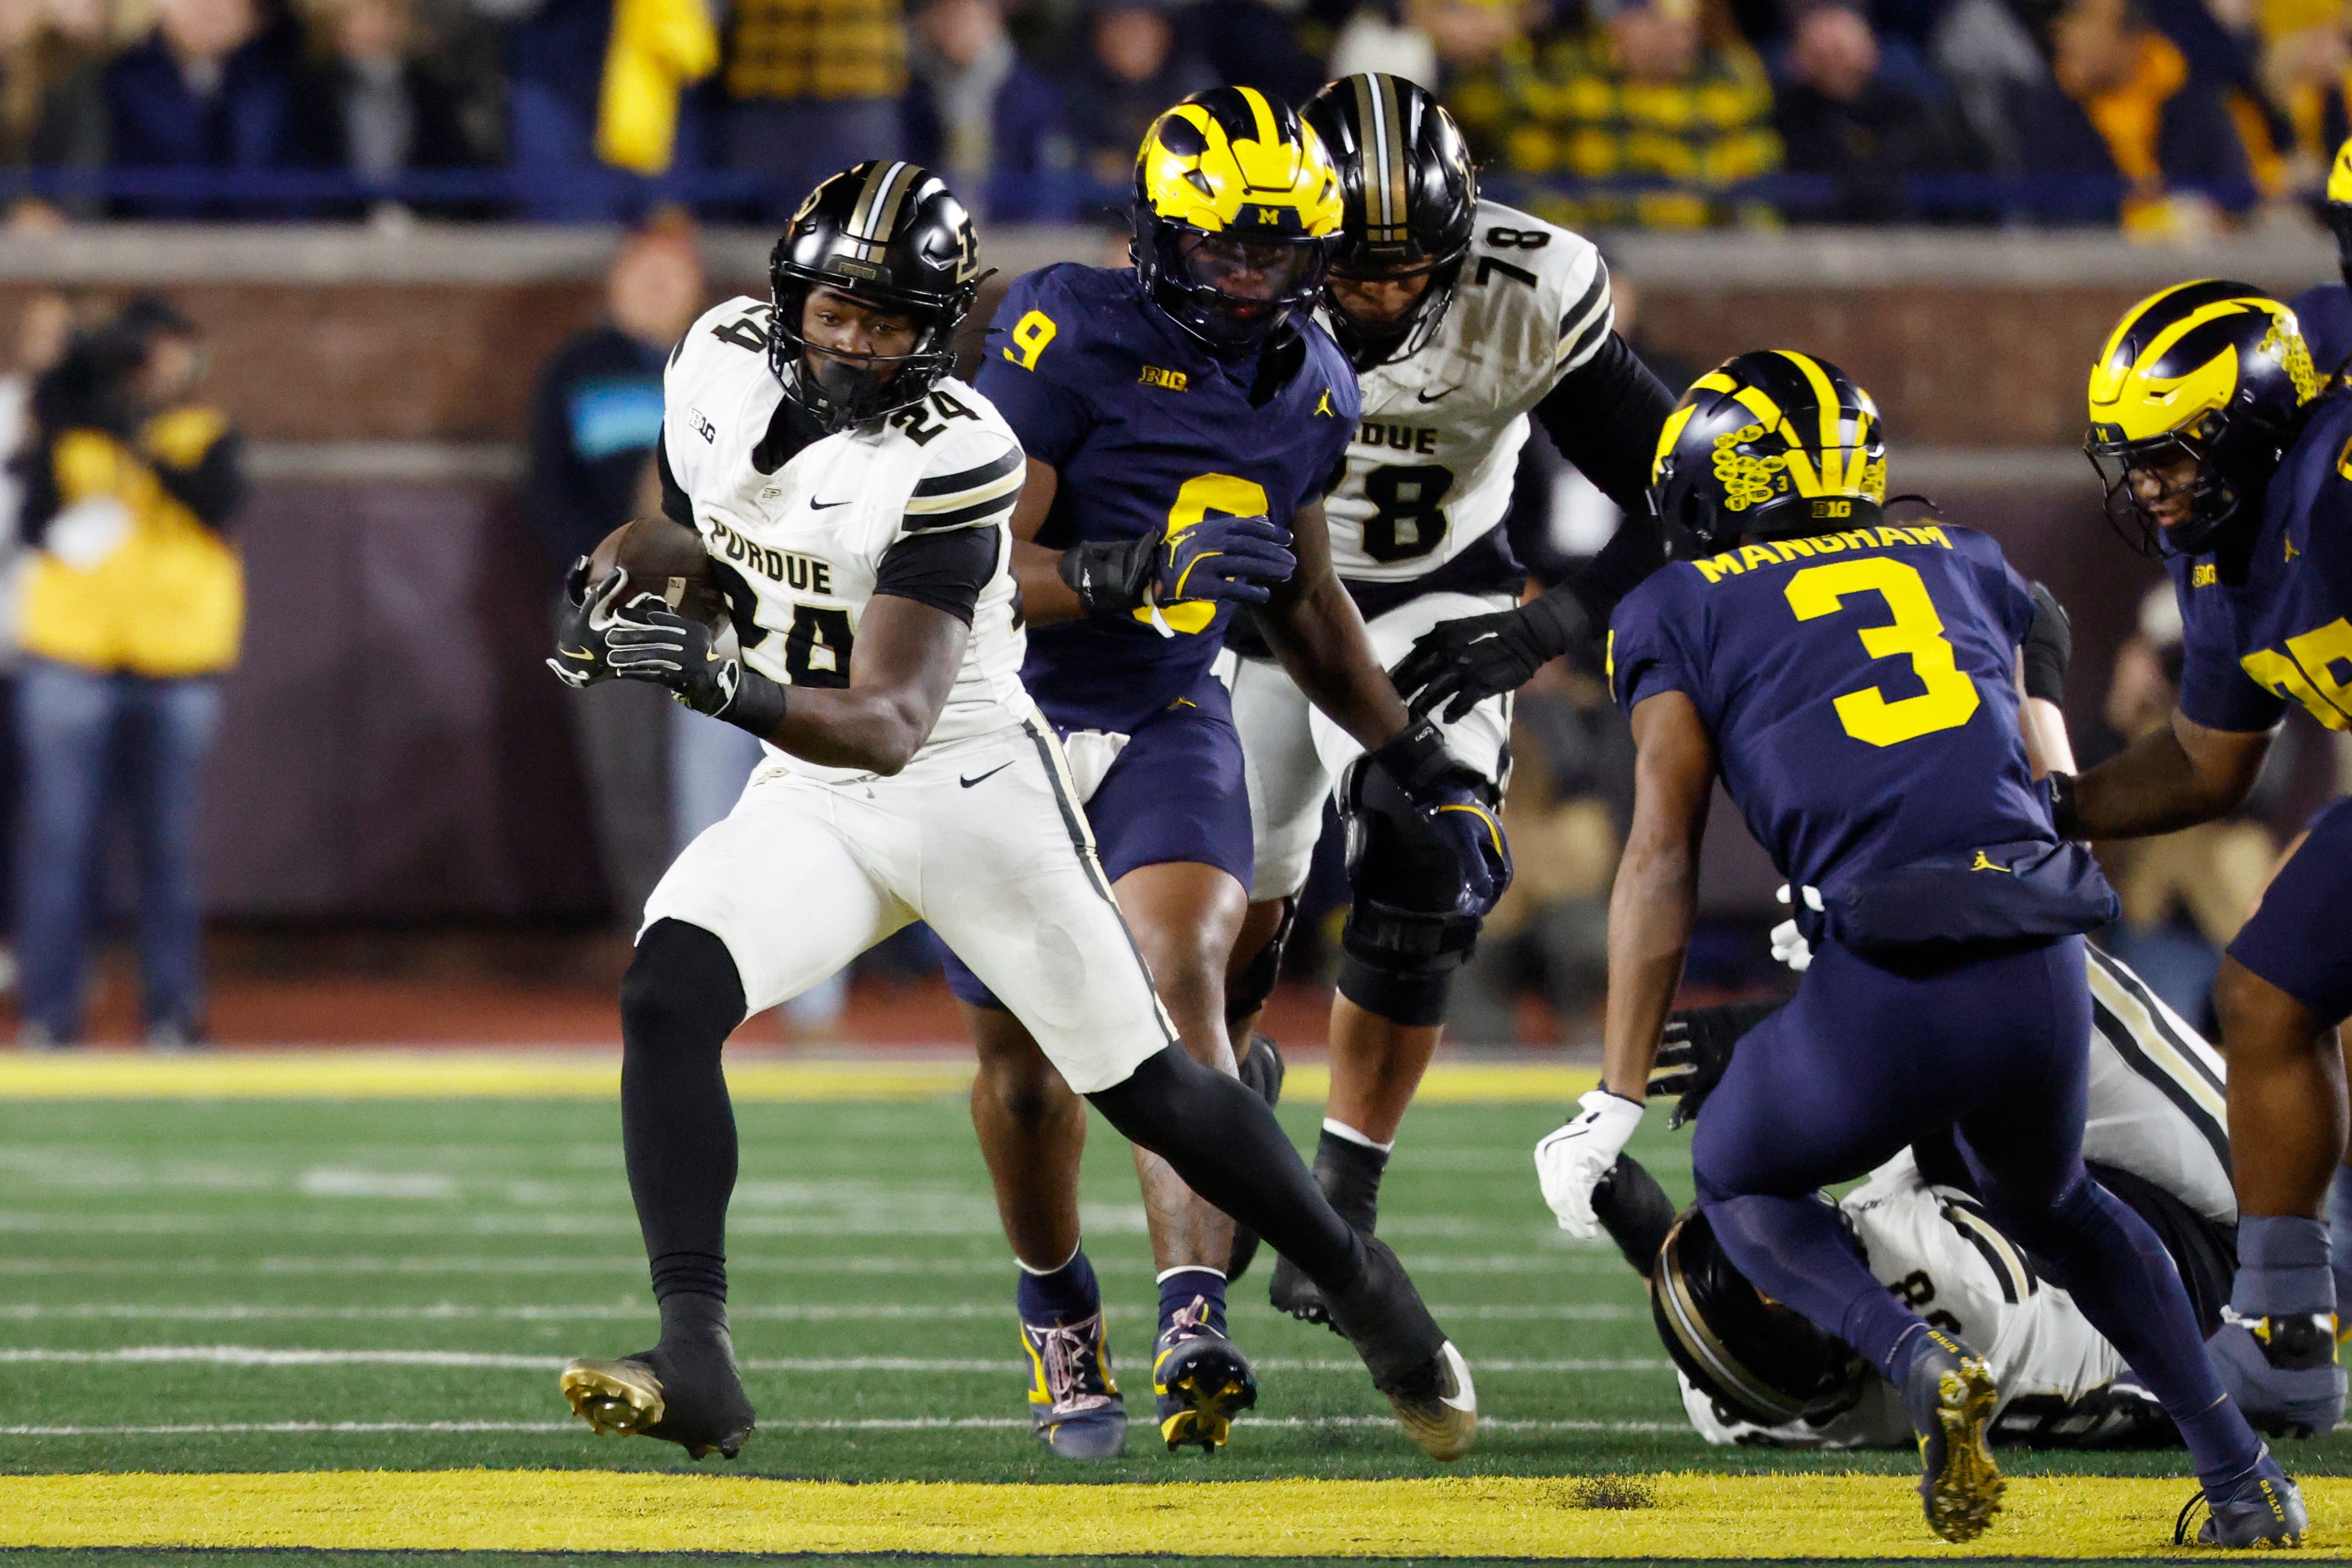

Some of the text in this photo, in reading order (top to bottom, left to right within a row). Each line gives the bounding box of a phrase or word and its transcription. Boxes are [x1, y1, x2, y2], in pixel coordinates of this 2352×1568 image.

[1258, 207, 1280, 225] M
[1474, 227, 1551, 289] 78
[1002, 309, 1058, 372] 9
[890, 391, 983, 448] 24
[709, 516, 833, 595] PURDUE
[1691, 525, 1953, 584] MANGHAM
[1783, 556, 1980, 747] 3
